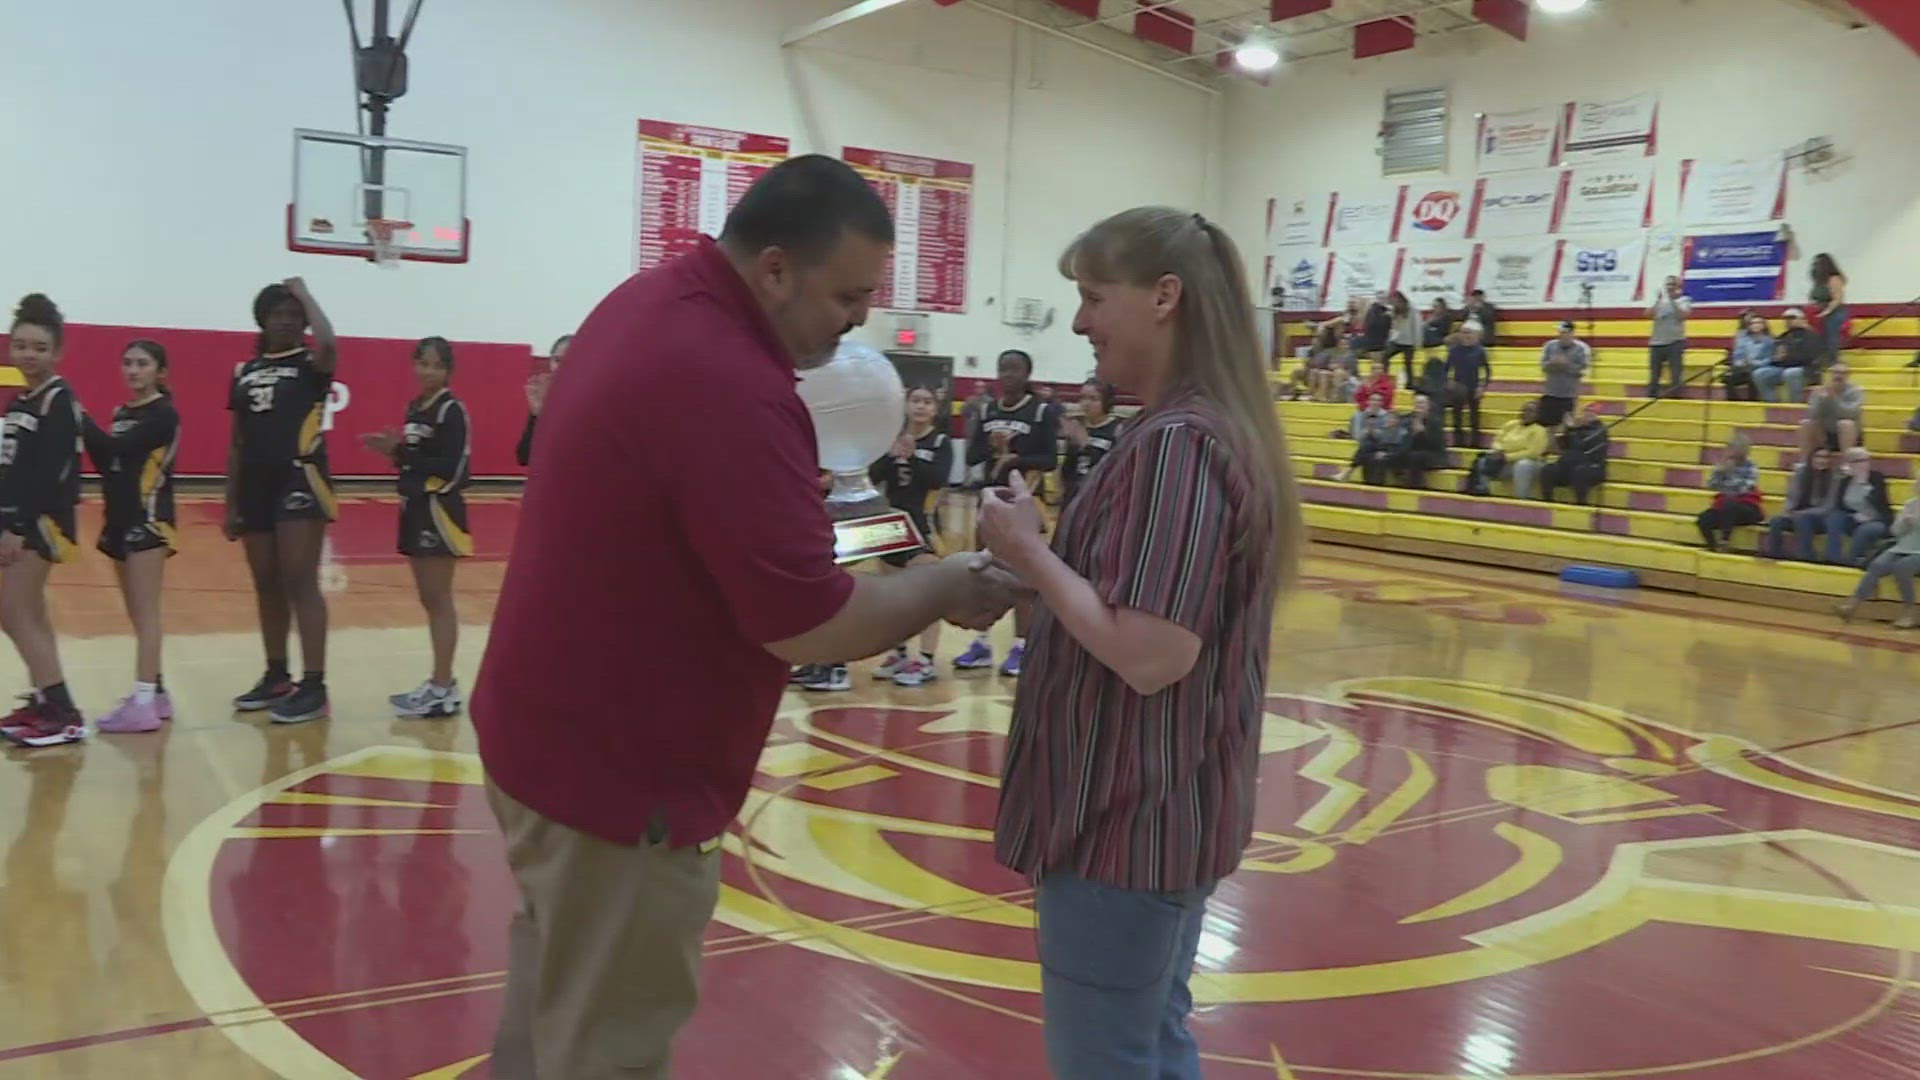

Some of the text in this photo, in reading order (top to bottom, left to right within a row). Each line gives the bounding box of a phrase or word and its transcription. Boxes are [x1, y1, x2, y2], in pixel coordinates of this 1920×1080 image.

[1419, 199, 1456, 219] DQ
[1576, 250, 1617, 272] STS
[247, 386, 274, 412] 31
[322, 381, 350, 431] P
